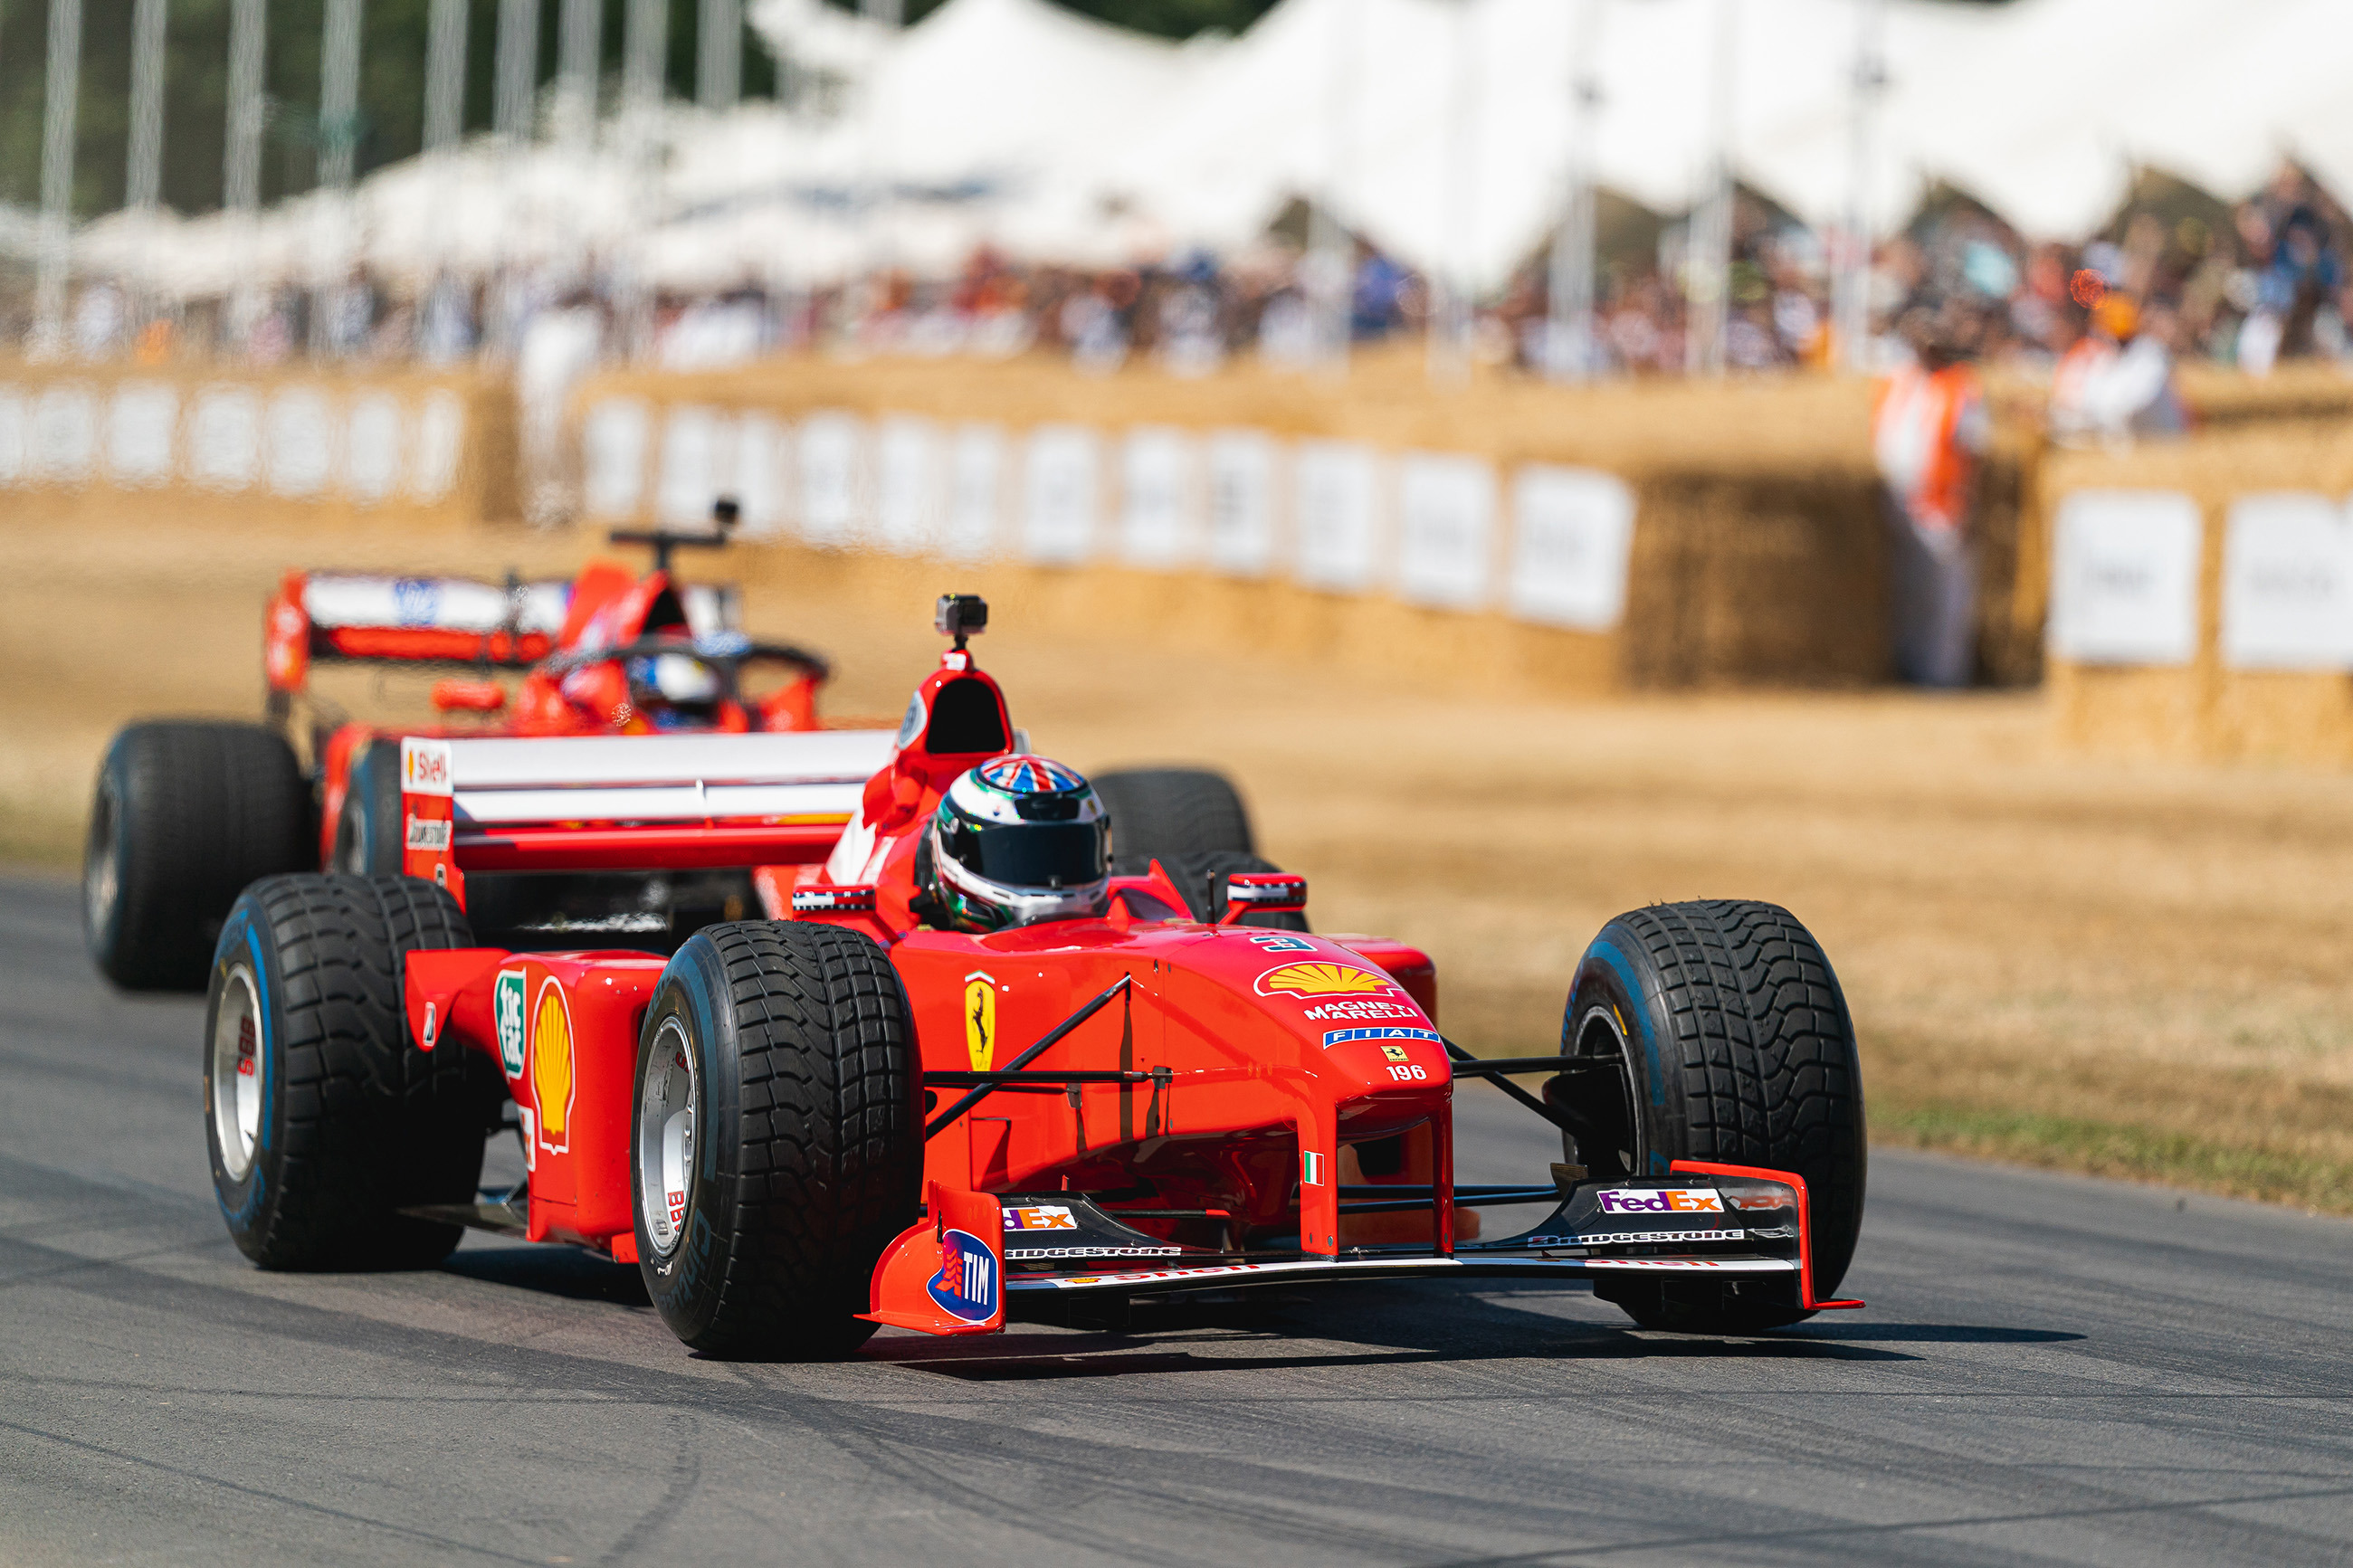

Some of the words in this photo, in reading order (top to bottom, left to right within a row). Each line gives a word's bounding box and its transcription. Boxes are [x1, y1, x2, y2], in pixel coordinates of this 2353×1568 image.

[500, 977, 520, 1030] tic
[1303, 1001, 1418, 1020] MAGNETI
[1303, 1006, 1418, 1021] MARELLI
[500, 1017, 522, 1066] tac
[1333, 1029, 1434, 1041] FIAT
[1386, 1064, 1427, 1081] 196
[1598, 1190, 1720, 1212] FedEx
[964, 1251, 989, 1306] TIM
